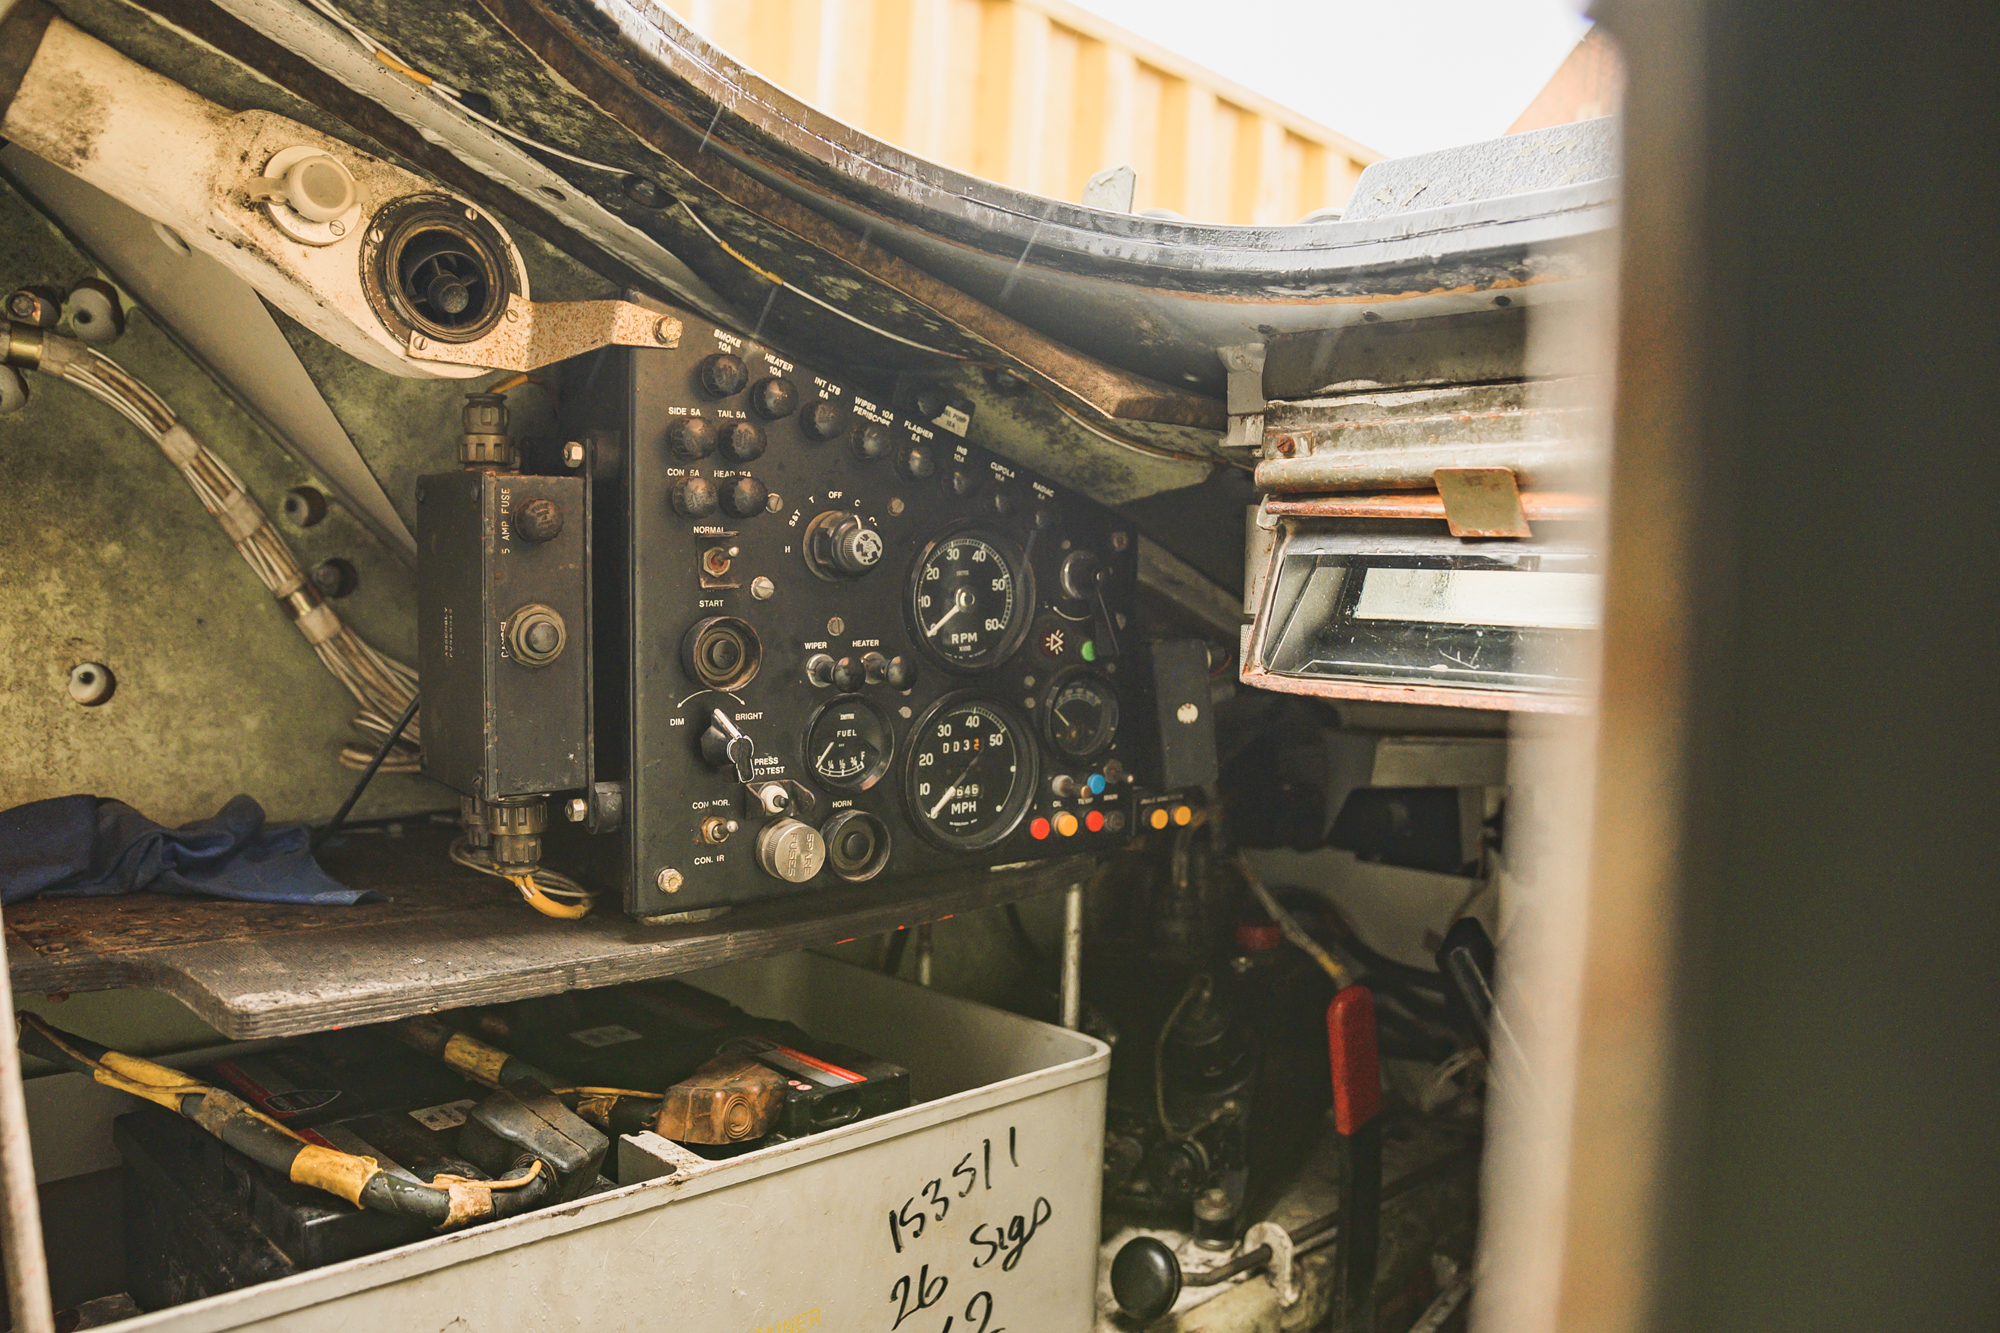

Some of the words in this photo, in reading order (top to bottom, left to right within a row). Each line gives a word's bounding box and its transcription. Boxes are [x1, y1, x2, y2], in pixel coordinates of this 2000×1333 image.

[713, 328, 742, 348] SMOKE
[717, 341, 732, 354] 10A
[763, 353, 794, 373] HEATER
[769, 365, 783, 378] 10A
[814, 376, 828, 391] INT
[828, 382, 841, 396] LTS
[668, 406, 687, 415] SIDE
[690, 407, 701, 417] 5A
[717, 409, 734, 418] TAIL
[735, 410, 747, 420] 5A
[854, 396, 877, 414] WIPER
[881, 409, 894, 422] 10A
[852, 405, 891, 428] PERISCOPE
[903, 420, 934, 440] FLASHER
[667, 468, 685, 477] CON
[690, 469, 700, 477] 5A
[713, 470, 736, 478] HEAD
[990, 461, 1015, 479] CUPOLA
[828, 491, 843, 499] OFF
[1032, 481, 1055, 498] RADIAC
[501, 488, 510, 515] FUSE
[808, 495, 815, 504] T
[854, 499, 861, 507] C
[788, 508, 802, 527] S&T
[501, 520, 510, 542] AMP
[784, 545, 791, 553] H
[946, 548, 960, 560] 30
[972, 550, 986, 562] 40
[926, 567, 940, 580] 20
[992, 579, 1006, 591] 50
[699, 599, 724, 608] START
[921, 595, 931, 608] 10
[985, 618, 999, 631] 60
[852, 639, 880, 648] HEATER
[951, 632, 978, 644] RPM
[804, 641, 827, 650] WIPER
[669, 717, 685, 726] DIM
[735, 711, 763, 721] BRIGHT
[965, 715, 980, 728] 40
[836, 729, 857, 738] FUEL
[937, 724, 952, 737] 30
[989, 733, 1003, 747] 50
[754, 756, 779, 766] PRESS
[860, 751, 866, 761] F
[919, 752, 934, 767] 20
[754, 767, 765, 776] TO
[766, 766, 785, 775] TEST
[920, 782, 931, 796] 10
[692, 801, 710, 810] CON
[832, 800, 853, 808] HORN
[950, 800, 977, 815] MPH
[694, 856, 714, 866] CON.
[716, 854, 725, 863] IR
[788, 832, 796, 878] FUSES
[805, 832, 815, 876] SPARE
